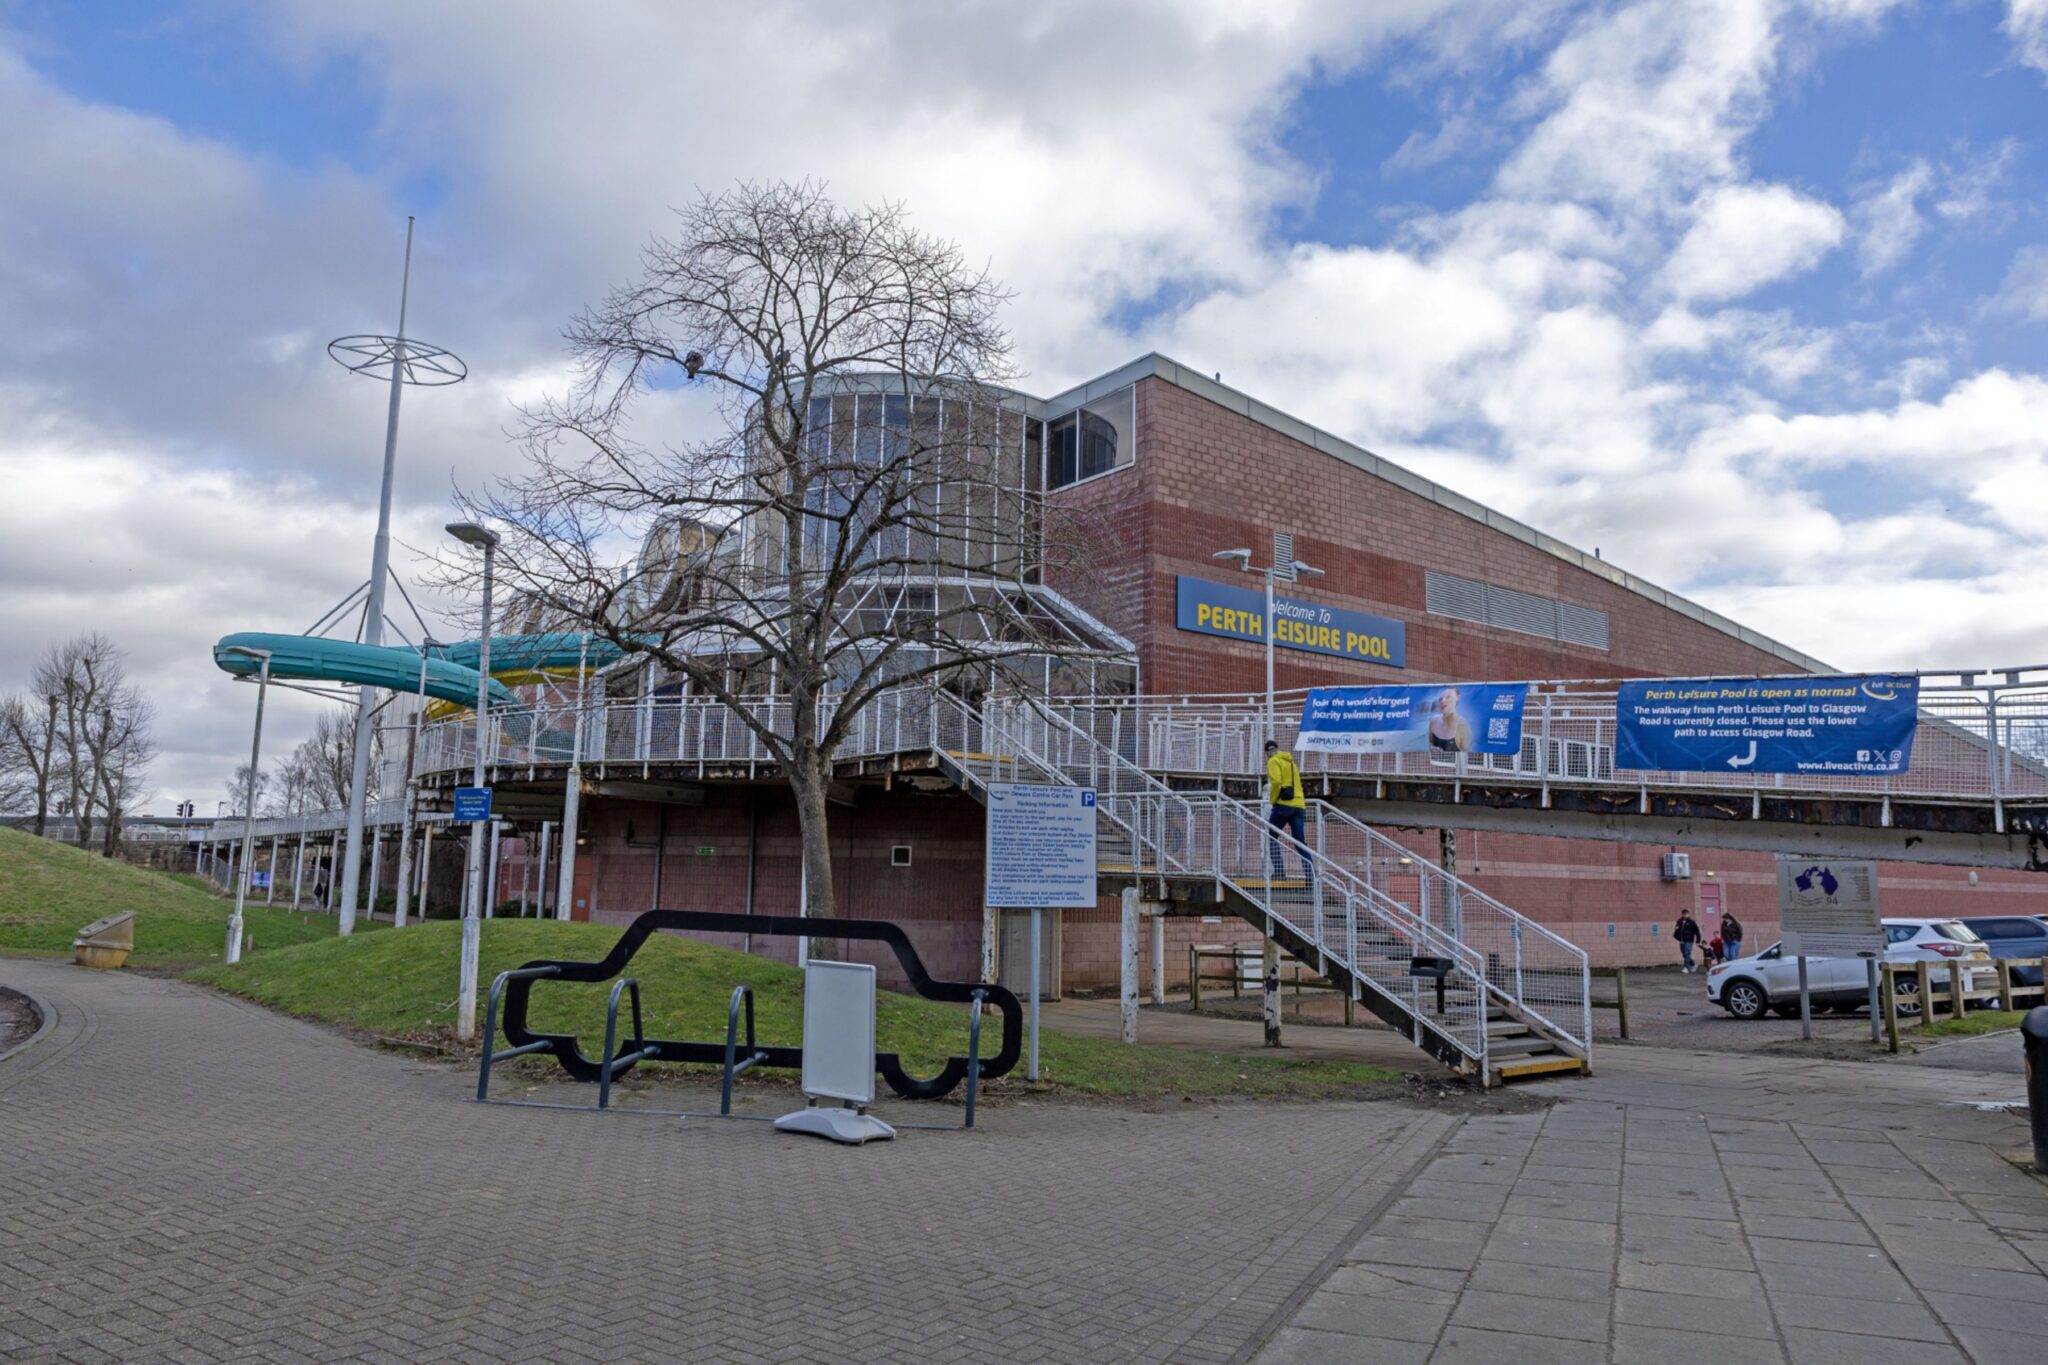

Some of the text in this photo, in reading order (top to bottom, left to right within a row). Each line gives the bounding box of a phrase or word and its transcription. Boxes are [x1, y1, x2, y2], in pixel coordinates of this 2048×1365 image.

[1318, 608, 1332, 624] To
[1197, 603, 1262, 637] PERTH
[1346, 631, 1391, 660] POOL
[1645, 686, 1856, 699] Perth Leisure Pool is open as normal
[1332, 698, 1345, 707] the
[1346, 696, 1377, 707] world's
[1377, 695, 1410, 708] largest
[1343, 709, 1384, 720] swimming
[1386, 709, 1410, 718] event
[1634, 703, 1867, 716] The walkway from Perth Leisure Pool to Glasgow
[1640, 716, 1858, 727] Road is currently closed. Please use the lower
[1674, 728, 1815, 739] path to access Glasgow Road.
[1797, 761, 1900, 771] www.liveactive.co.uk
[1085, 793, 1093, 805] P
